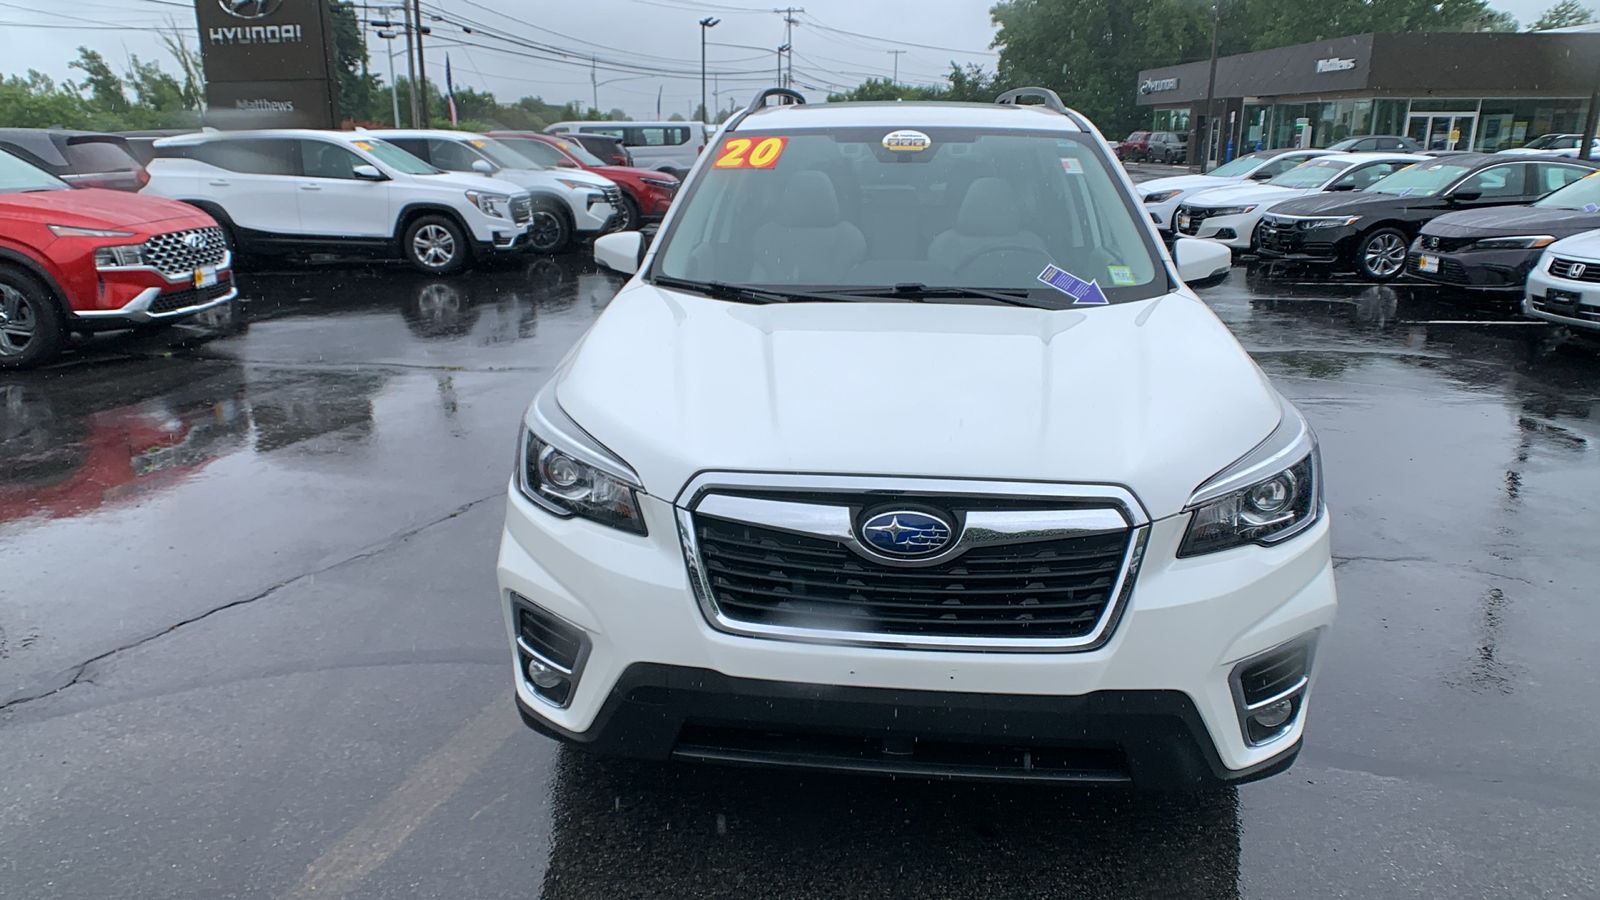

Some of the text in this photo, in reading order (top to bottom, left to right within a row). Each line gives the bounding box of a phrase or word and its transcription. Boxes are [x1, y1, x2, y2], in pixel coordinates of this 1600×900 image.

[209, 24, 302, 45] HYUNDAI
[235, 99, 294, 111] Matthews
[715, 137, 783, 168] 20
